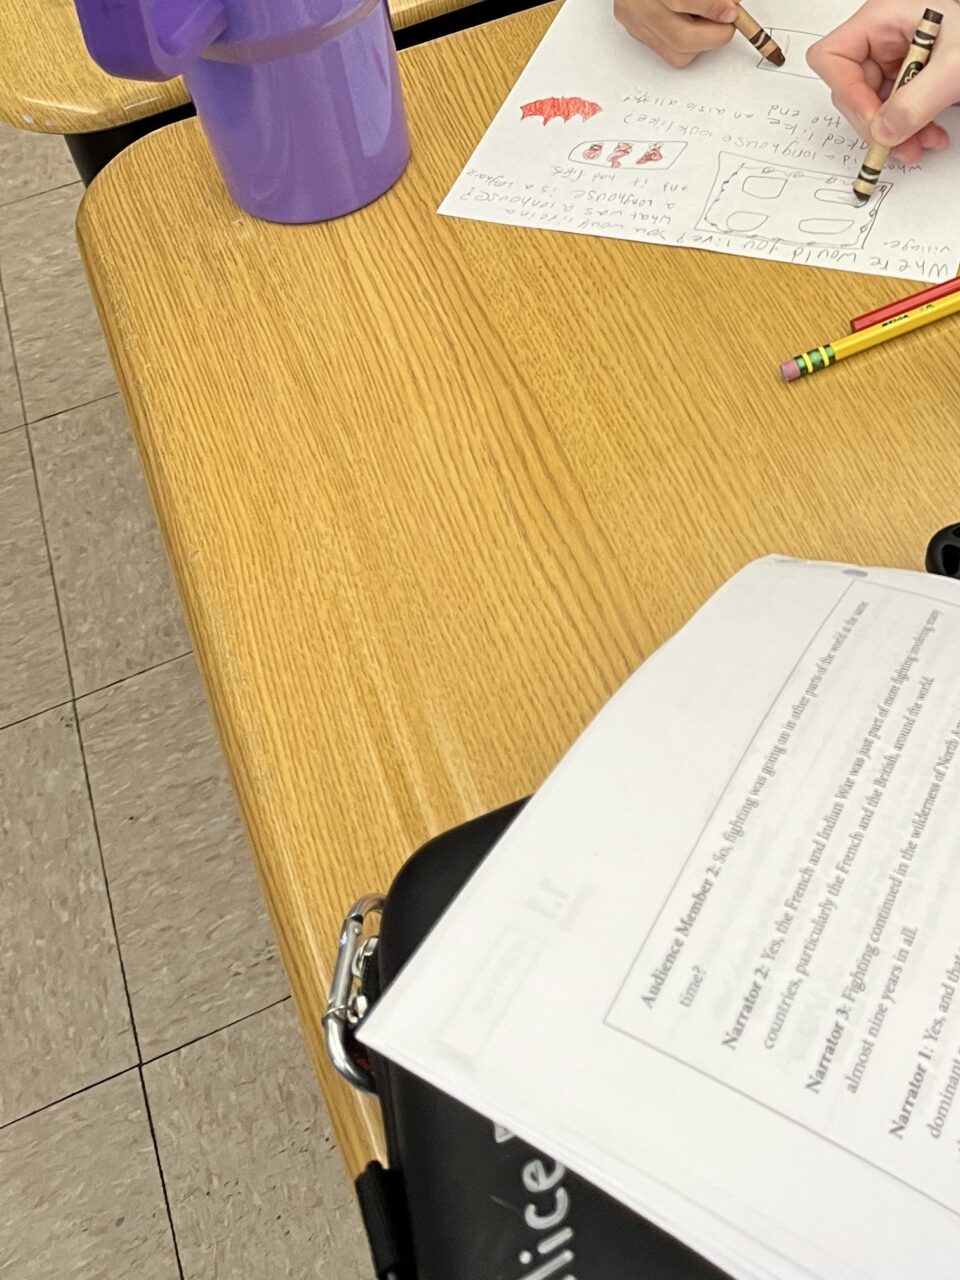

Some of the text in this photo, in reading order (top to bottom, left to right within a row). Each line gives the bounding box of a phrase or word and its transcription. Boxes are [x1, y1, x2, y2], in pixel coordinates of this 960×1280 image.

[834, 776, 856, 799] War
[865, 788, 884, 807] the
[722, 796, 760, 843] fighting
[816, 801, 845, 840] Indian
[858, 805, 875, 831] and
[712, 846, 734, 864] So,
[809, 838, 827, 866] and
[835, 831, 865, 874] French
[784, 865, 816, 911] French
[826, 874, 846, 896] the
[675, 877, 714, 937] Member
[775, 912, 795, 934] the
[760, 938, 786, 961] Yes,
[795, 897, 838, 977] particularly
[805, 1020, 845, 1094] Narrator
[841, 942, 881, 1003] Fighting
[870, 874, 904, 942] continued
[900, 840, 918, 861] the
[911, 782, 942, 838] wilderness
[641, 937, 685, 1009] Audience
[679, 964, 707, 1007] time?
[722, 979, 763, 1050] Narrator
[764, 978, 804, 1050] countries,
[845, 1038, 875, 1094] almost
[868, 1002, 889, 1038] nine
[882, 964, 903, 1004] years
[901, 925, 919, 947] all.
[889, 1062, 927, 1140] Narrator
[923, 1016, 947, 1042] Yes,
[938, 982, 956, 1013] and
